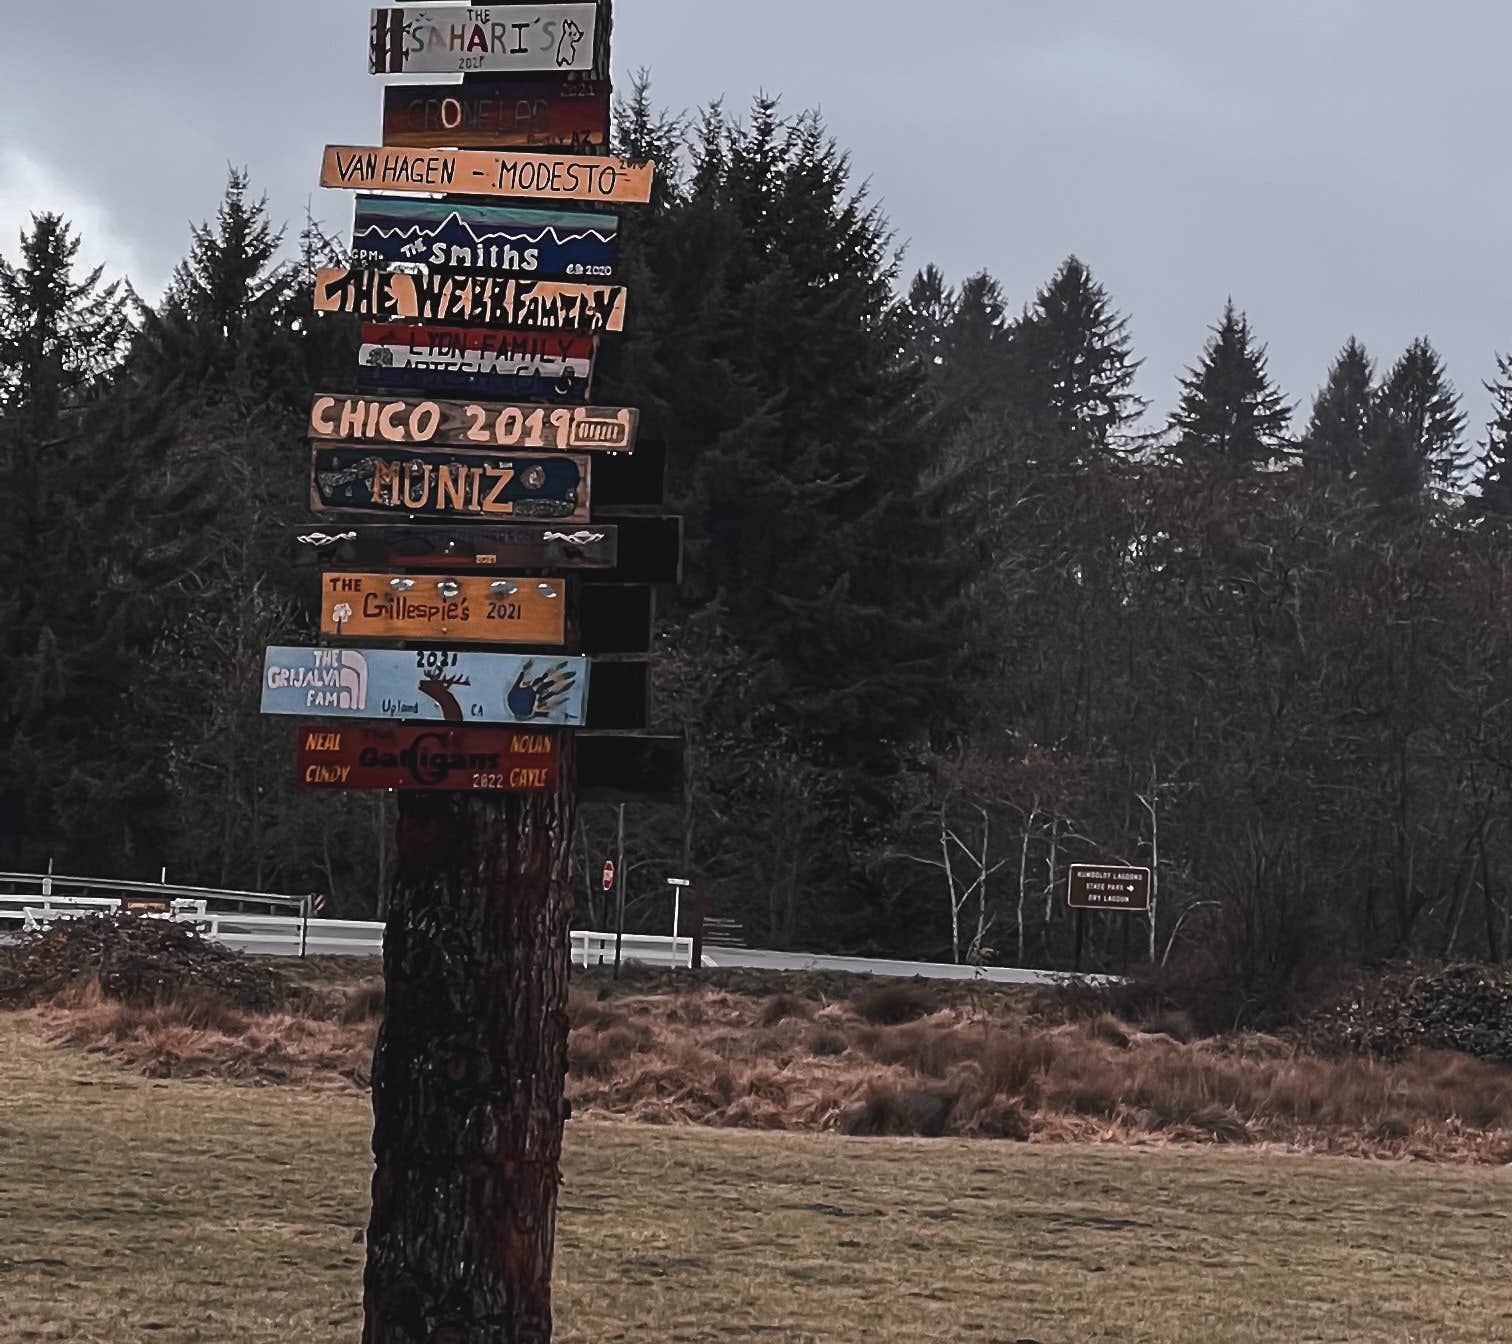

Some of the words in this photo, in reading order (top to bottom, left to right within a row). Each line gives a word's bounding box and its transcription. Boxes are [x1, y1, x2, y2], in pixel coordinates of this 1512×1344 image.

[467, 8, 492, 25] THE
[336, 151, 377, 182] VAN
[382, 154, 456, 185] HAGEN
[499, 159, 617, 196] MODESTO
[428, 242, 539, 271] Smiths
[409, 332, 467, 360] LYON
[480, 334, 575, 363] FAMILY
[310, 396, 442, 443] CHICO
[464, 404, 572, 449] 2019
[370, 459, 515, 514] MUNIZ
[329, 577, 362, 593] THE
[362, 592, 470, 622] Gillespie's
[486, 601, 522, 621] 2021
[313, 648, 341, 668] THE
[416, 650, 458, 668] 2021
[267, 665, 340, 689] GRIJALVA
[305, 763, 351, 784] CINDY
[509, 767, 550, 788] GAYLE
